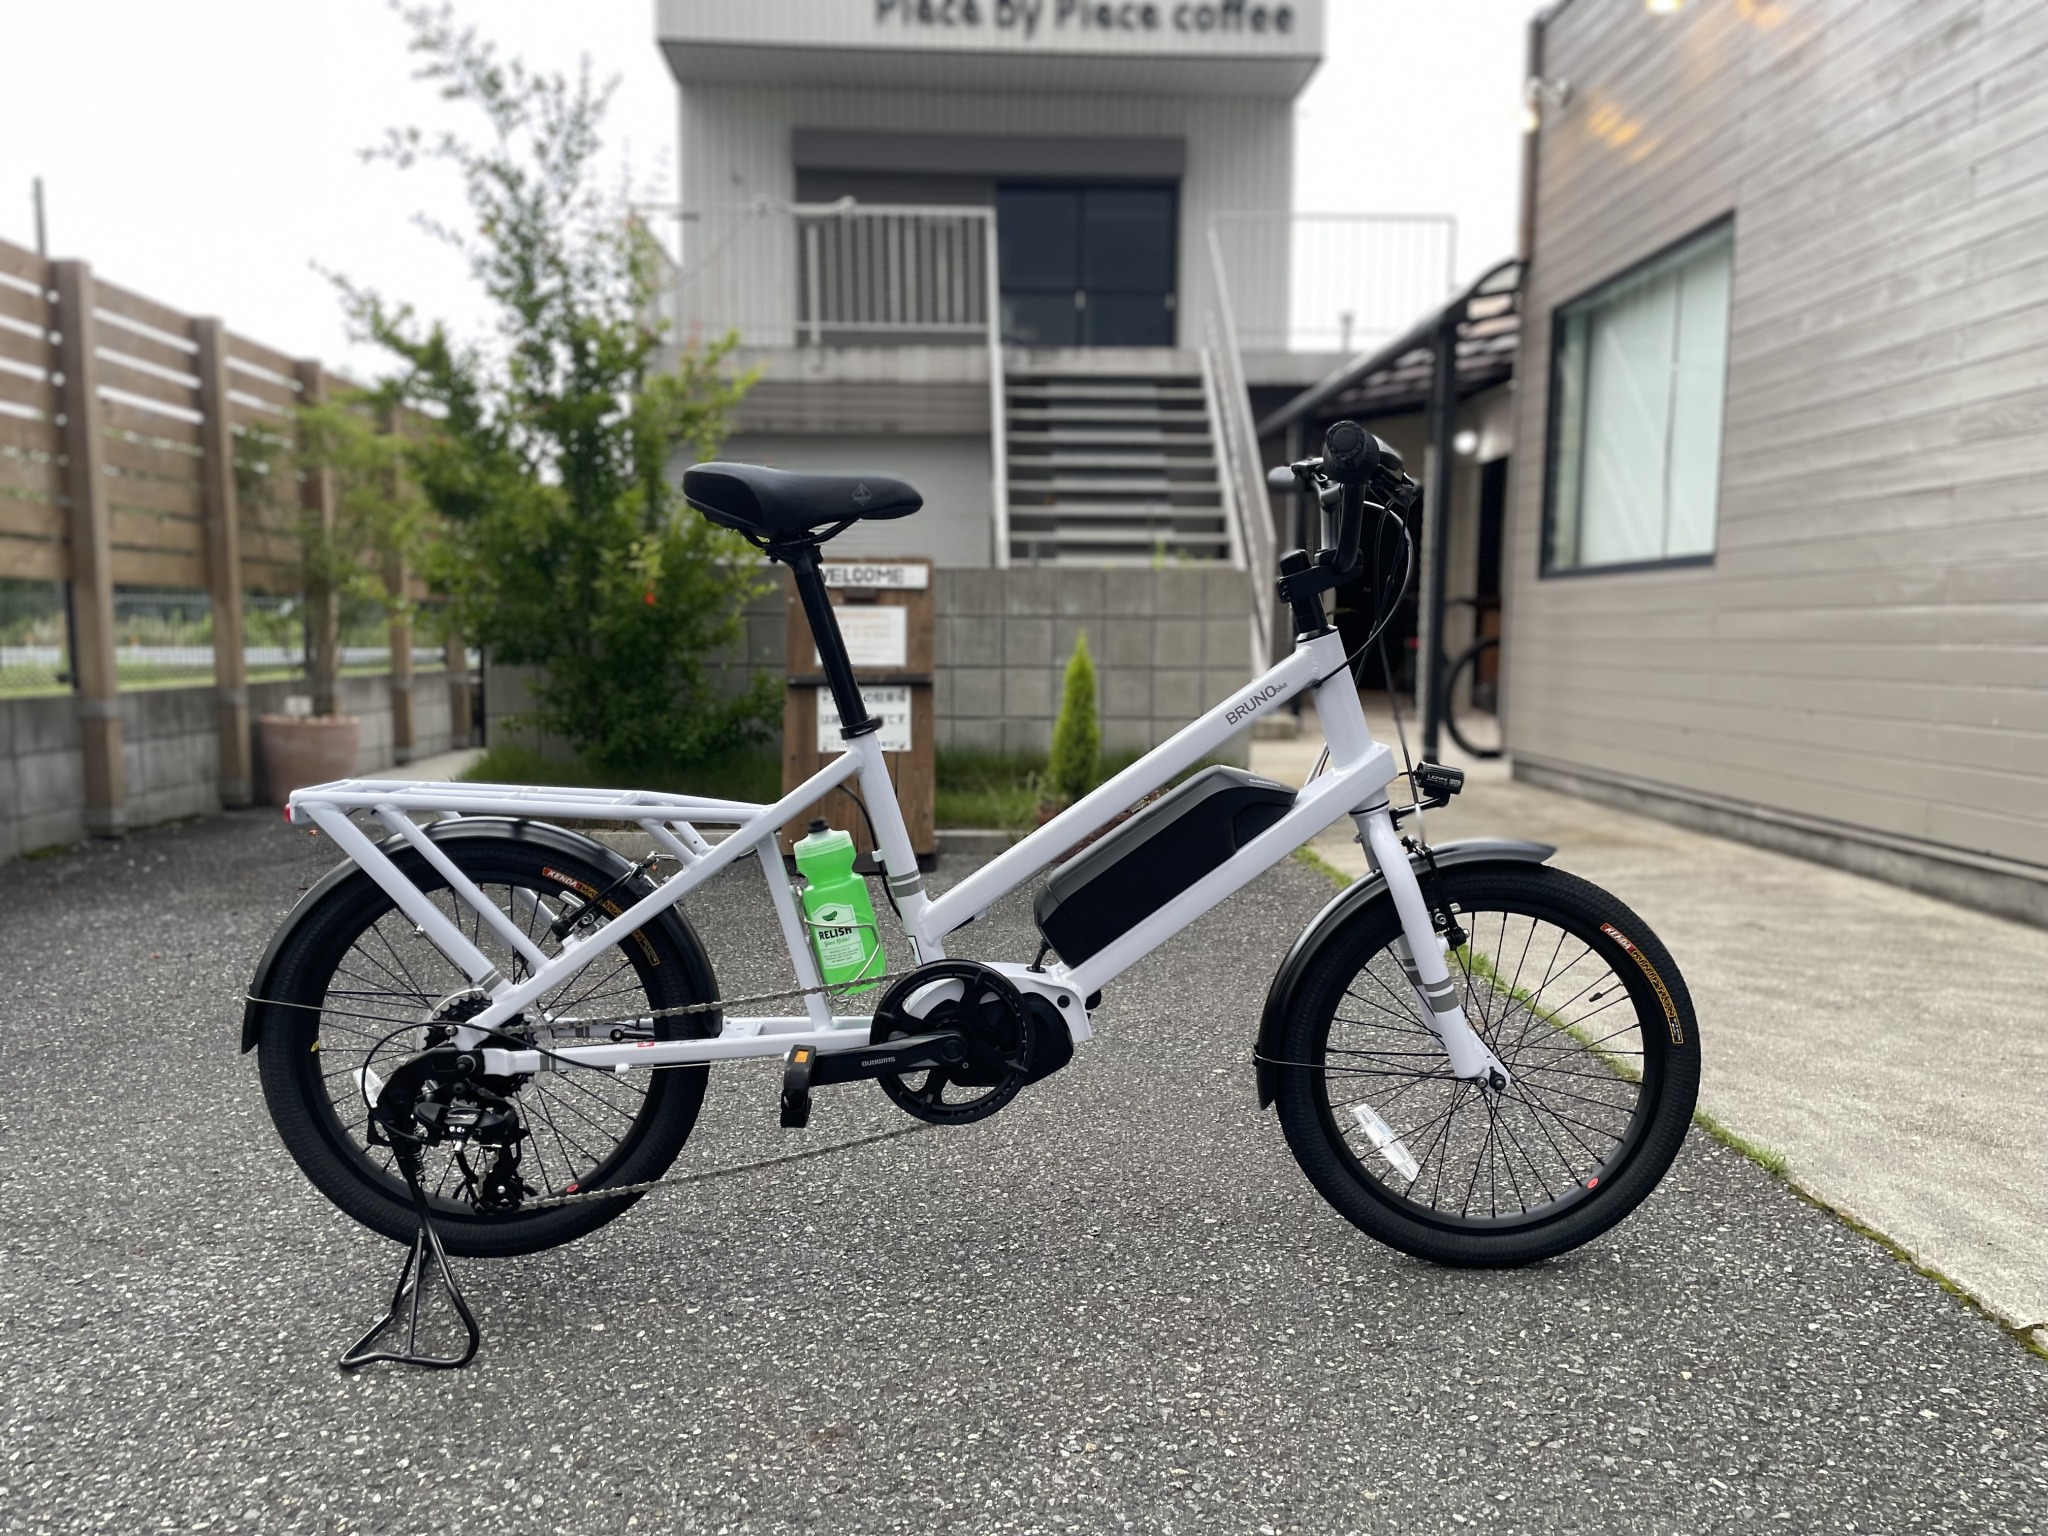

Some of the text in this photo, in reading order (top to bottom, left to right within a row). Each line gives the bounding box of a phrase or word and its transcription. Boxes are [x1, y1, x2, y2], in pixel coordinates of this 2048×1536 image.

[1173, 0, 1294, 34] coffee
[1225, 685, 1277, 725] BRUNO
[547, 871, 578, 888] KENDA
[818, 927, 852, 940] RELISH
[1604, 927, 1631, 950] KENDA
[861, 1056, 896, 1067] SHIMANO
